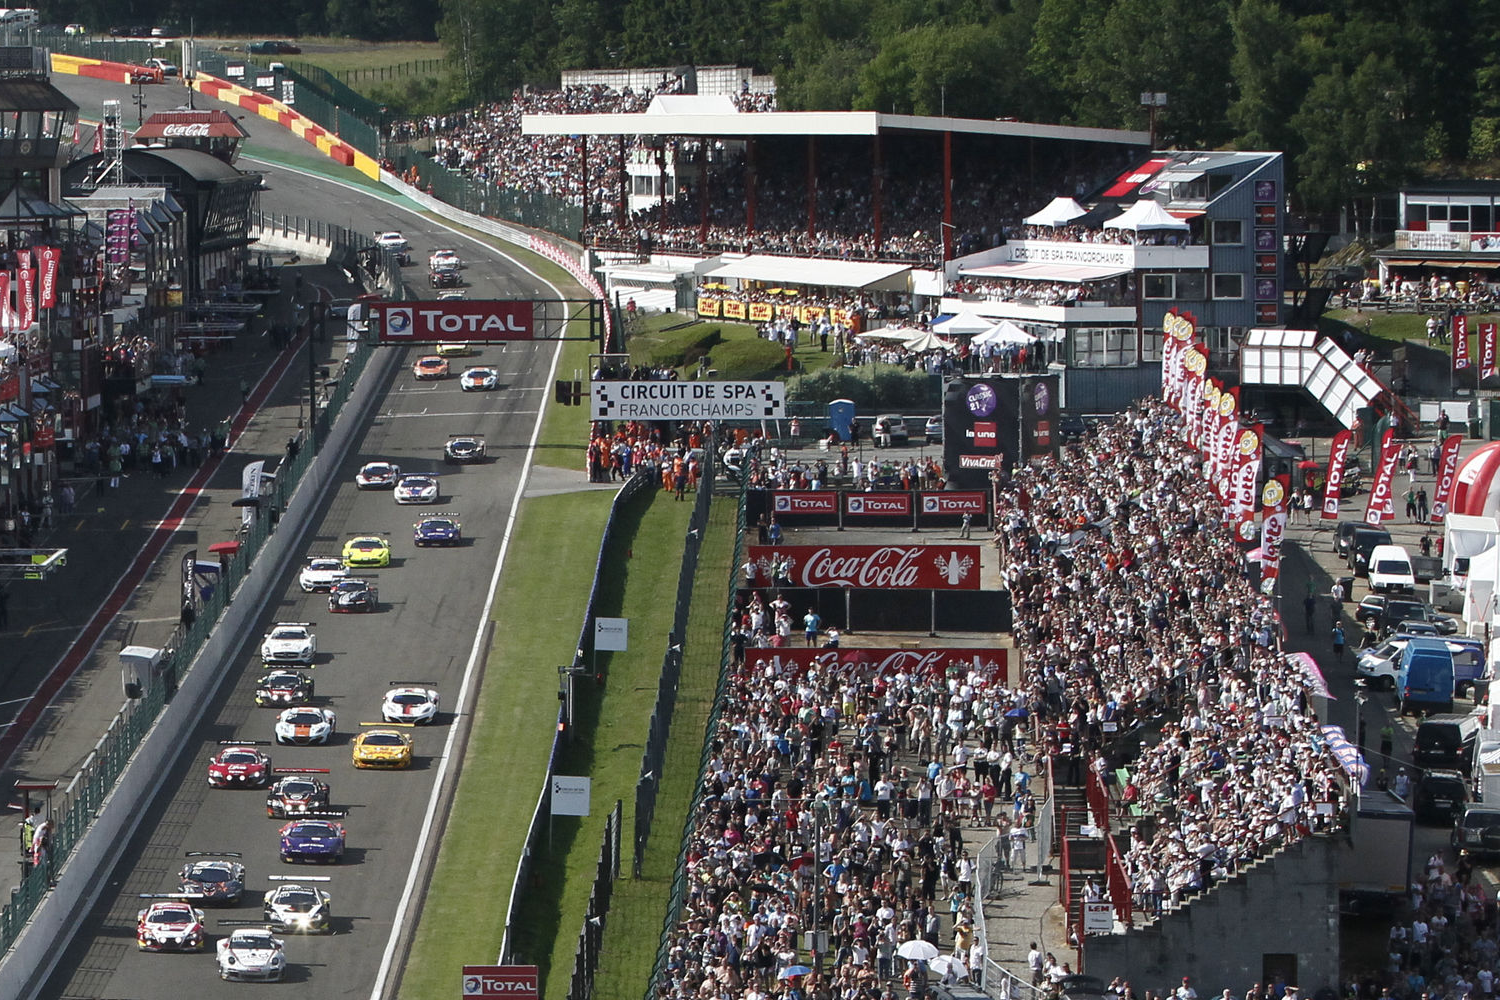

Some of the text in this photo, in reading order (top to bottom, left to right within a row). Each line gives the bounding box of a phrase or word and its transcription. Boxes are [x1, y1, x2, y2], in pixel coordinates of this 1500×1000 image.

[163, 123, 211, 137] Coca-Cola
[420, 310, 526, 332] TOTAL
[1456, 317, 1466, 360] TOTAL
[1482, 323, 1493, 368] TOTAL
[621, 384, 757, 400] CIRCUIT DE SPA
[619, 403, 753, 417] FRANCORCHAMPS
[966, 429, 996, 439] la une
[1327, 438, 1349, 495] TOTAL
[1437, 442, 1460, 497] TOTAL
[1240, 464, 1252, 507] lotto
[1371, 451, 1398, 507] TOTAL
[792, 499, 832, 510] TOTAL
[865, 501, 905, 511] TOTAL
[940, 499, 980, 510] TOTAL
[1266, 516, 1282, 562] lotto
[802, 547, 925, 588] Coca-Cola
[483, 979, 537, 992] TOTAL
